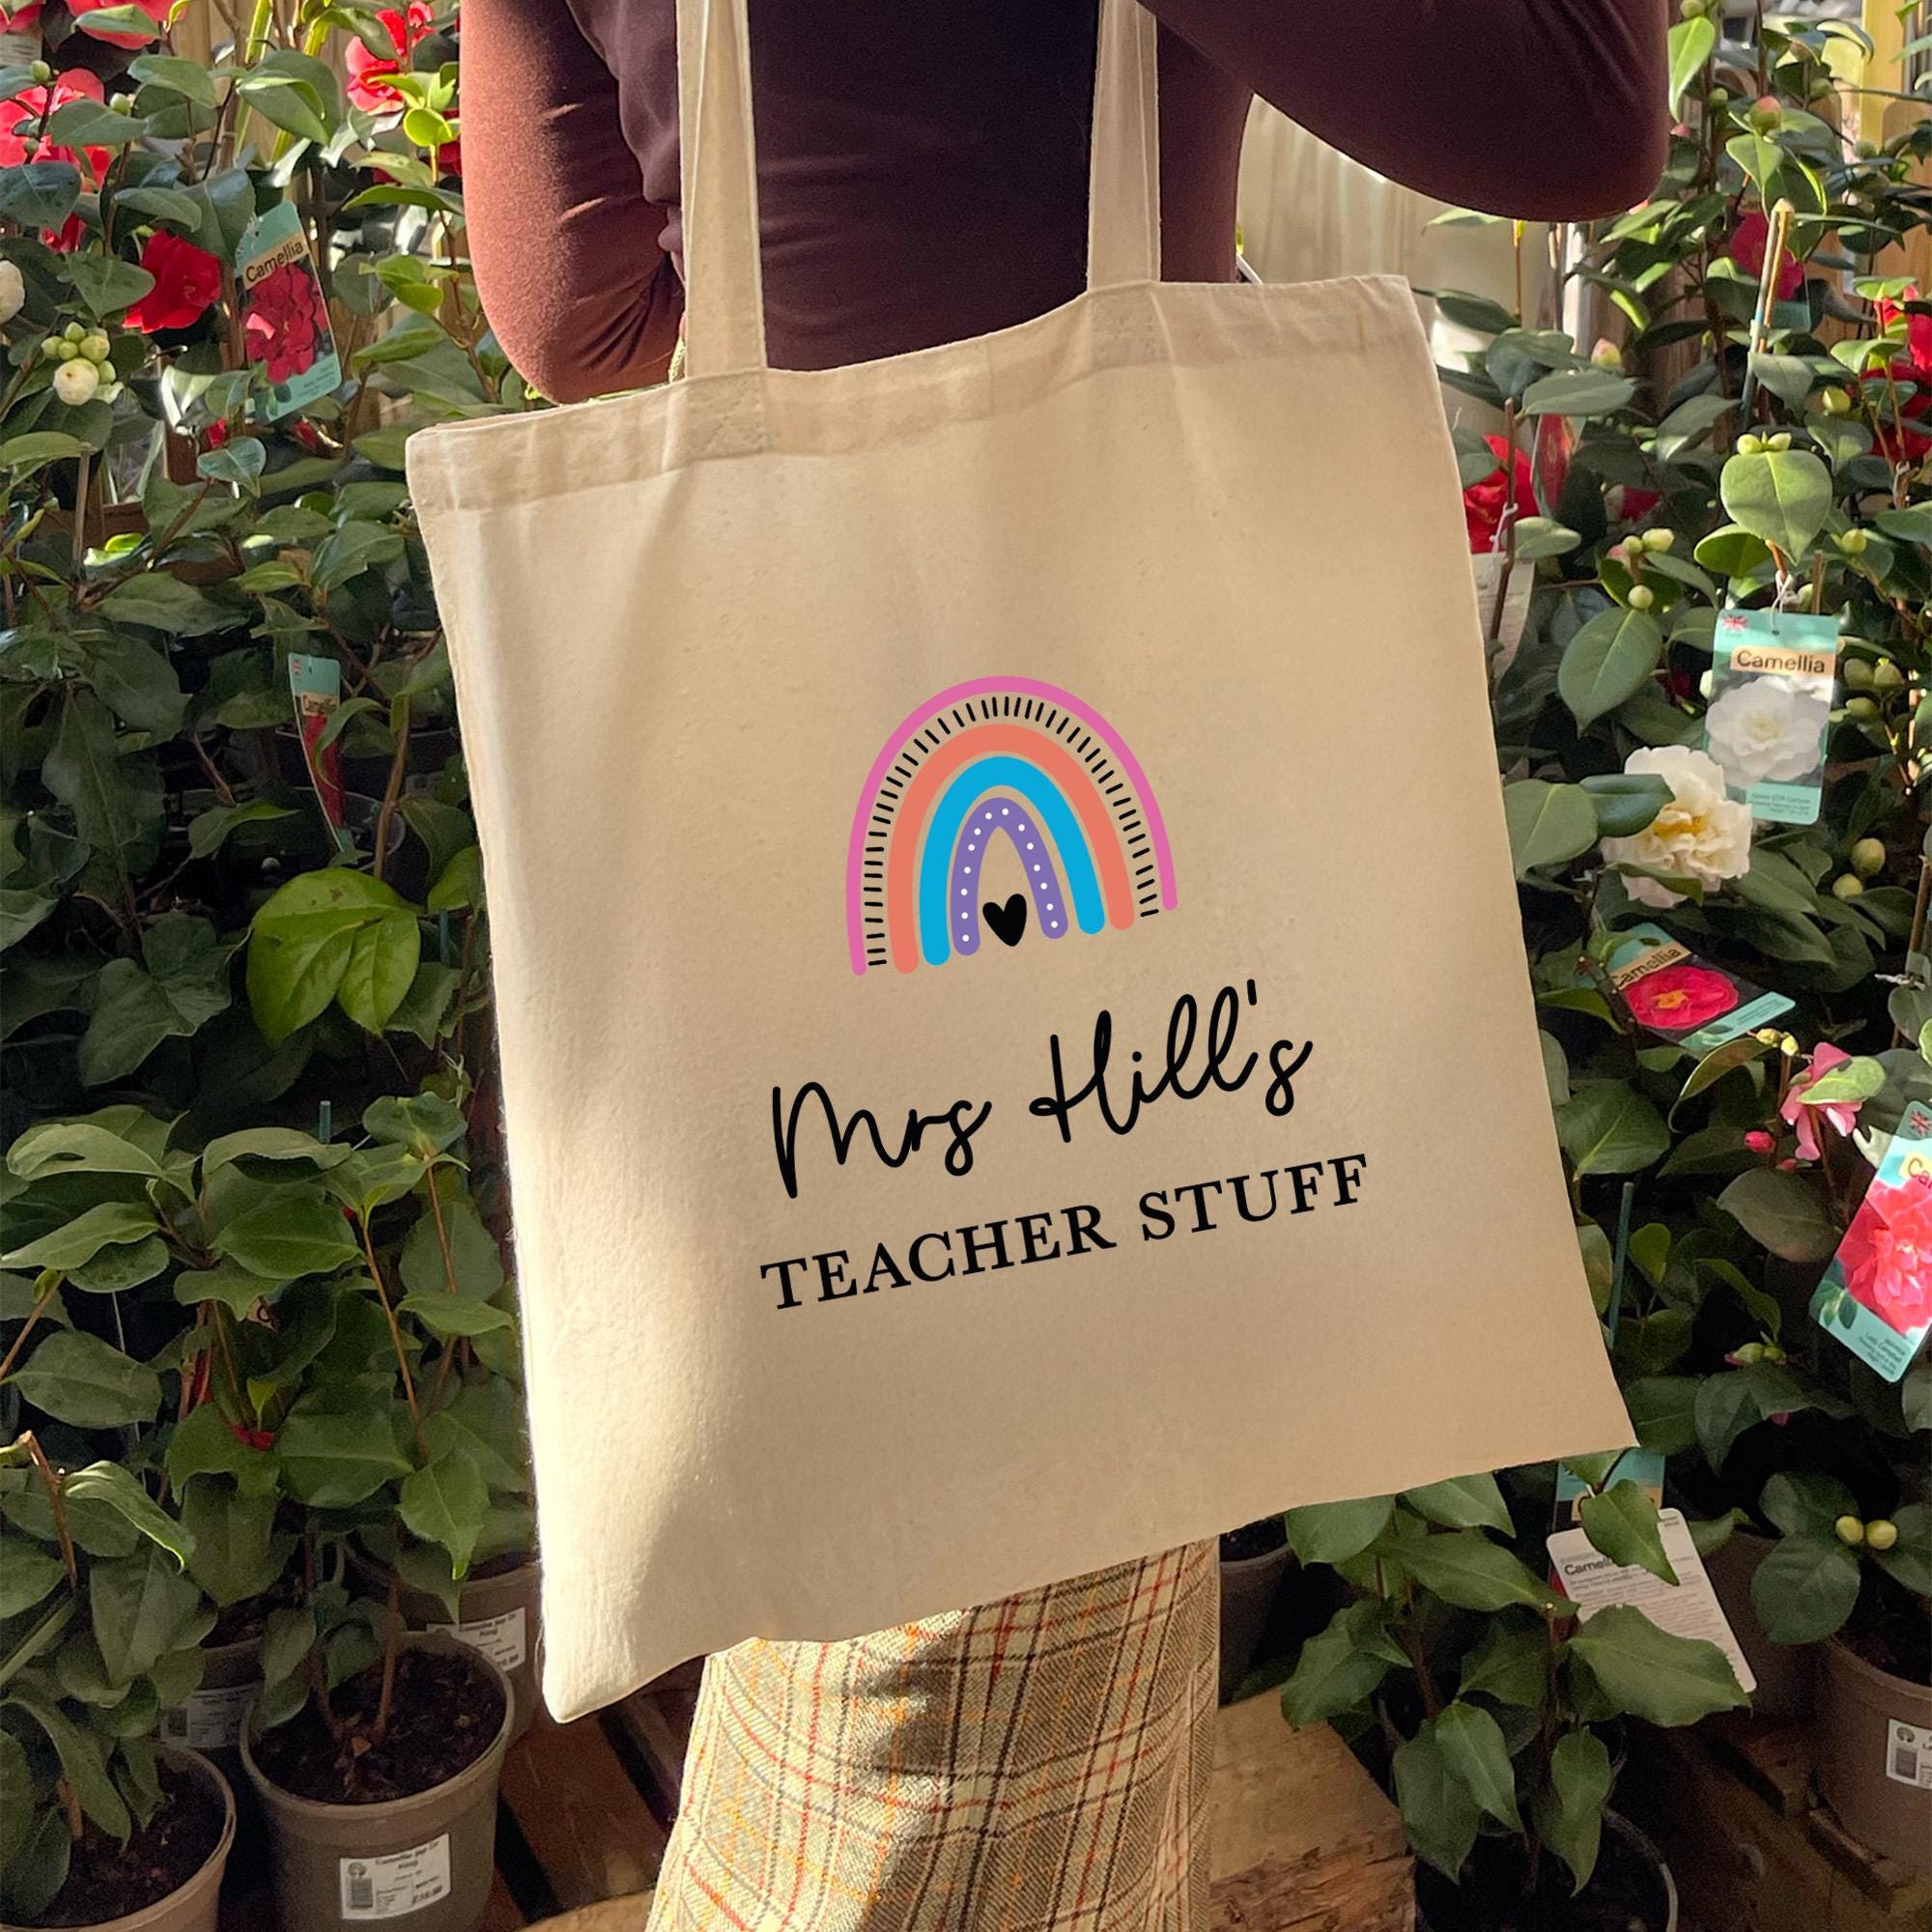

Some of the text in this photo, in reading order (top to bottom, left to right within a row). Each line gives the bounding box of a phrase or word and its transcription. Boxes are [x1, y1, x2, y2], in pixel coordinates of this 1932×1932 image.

[246, 241, 304, 283] Camellia
[1737, 650, 1825, 673] Camellia
[772, 979, 1314, 1200] Mrs Hill's
[759, 1153, 1367, 1310] TEACHER STUFF
